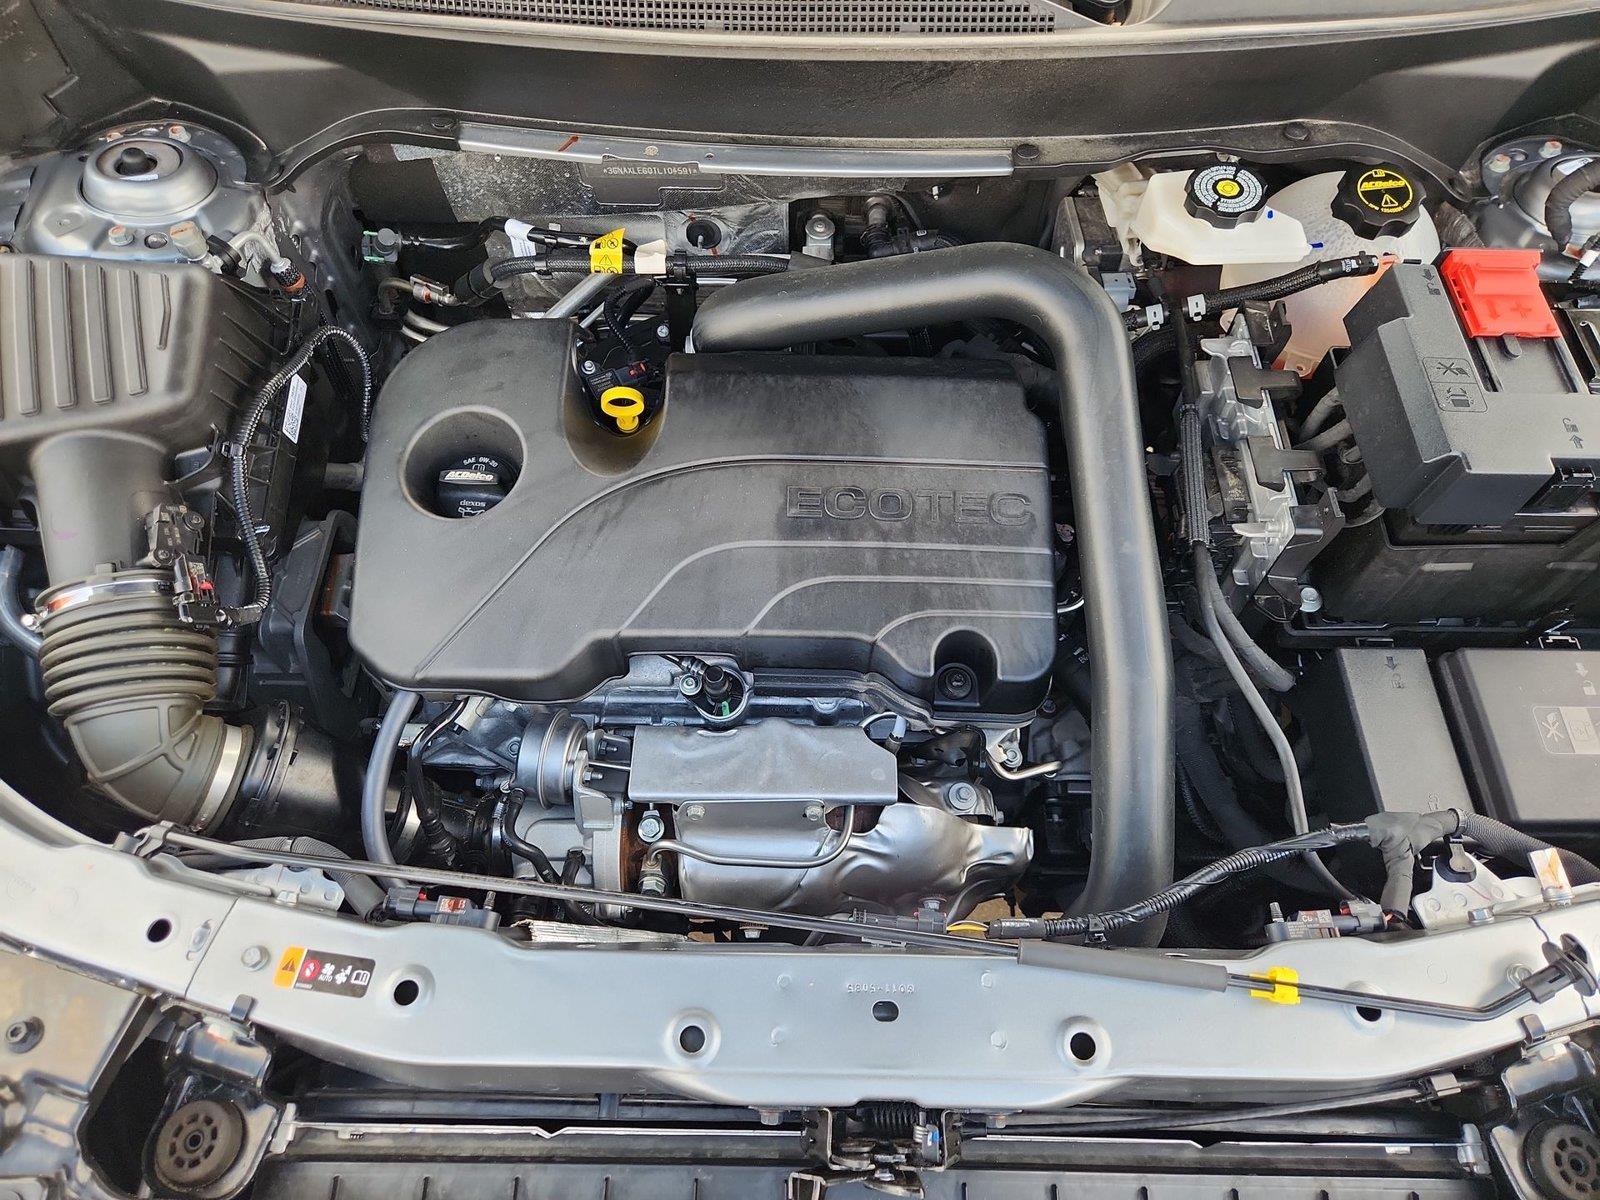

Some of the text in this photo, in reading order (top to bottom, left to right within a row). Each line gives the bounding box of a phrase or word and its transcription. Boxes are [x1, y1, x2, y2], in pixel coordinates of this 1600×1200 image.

[1361, 180, 1405, 189] ACDelco
[463, 457, 498, 468] SAE 0W-20
[444, 471, 494, 481] ACDelco
[786, 485, 1036, 526] ECOTEC
[318, 974, 333, 982] AUTO
